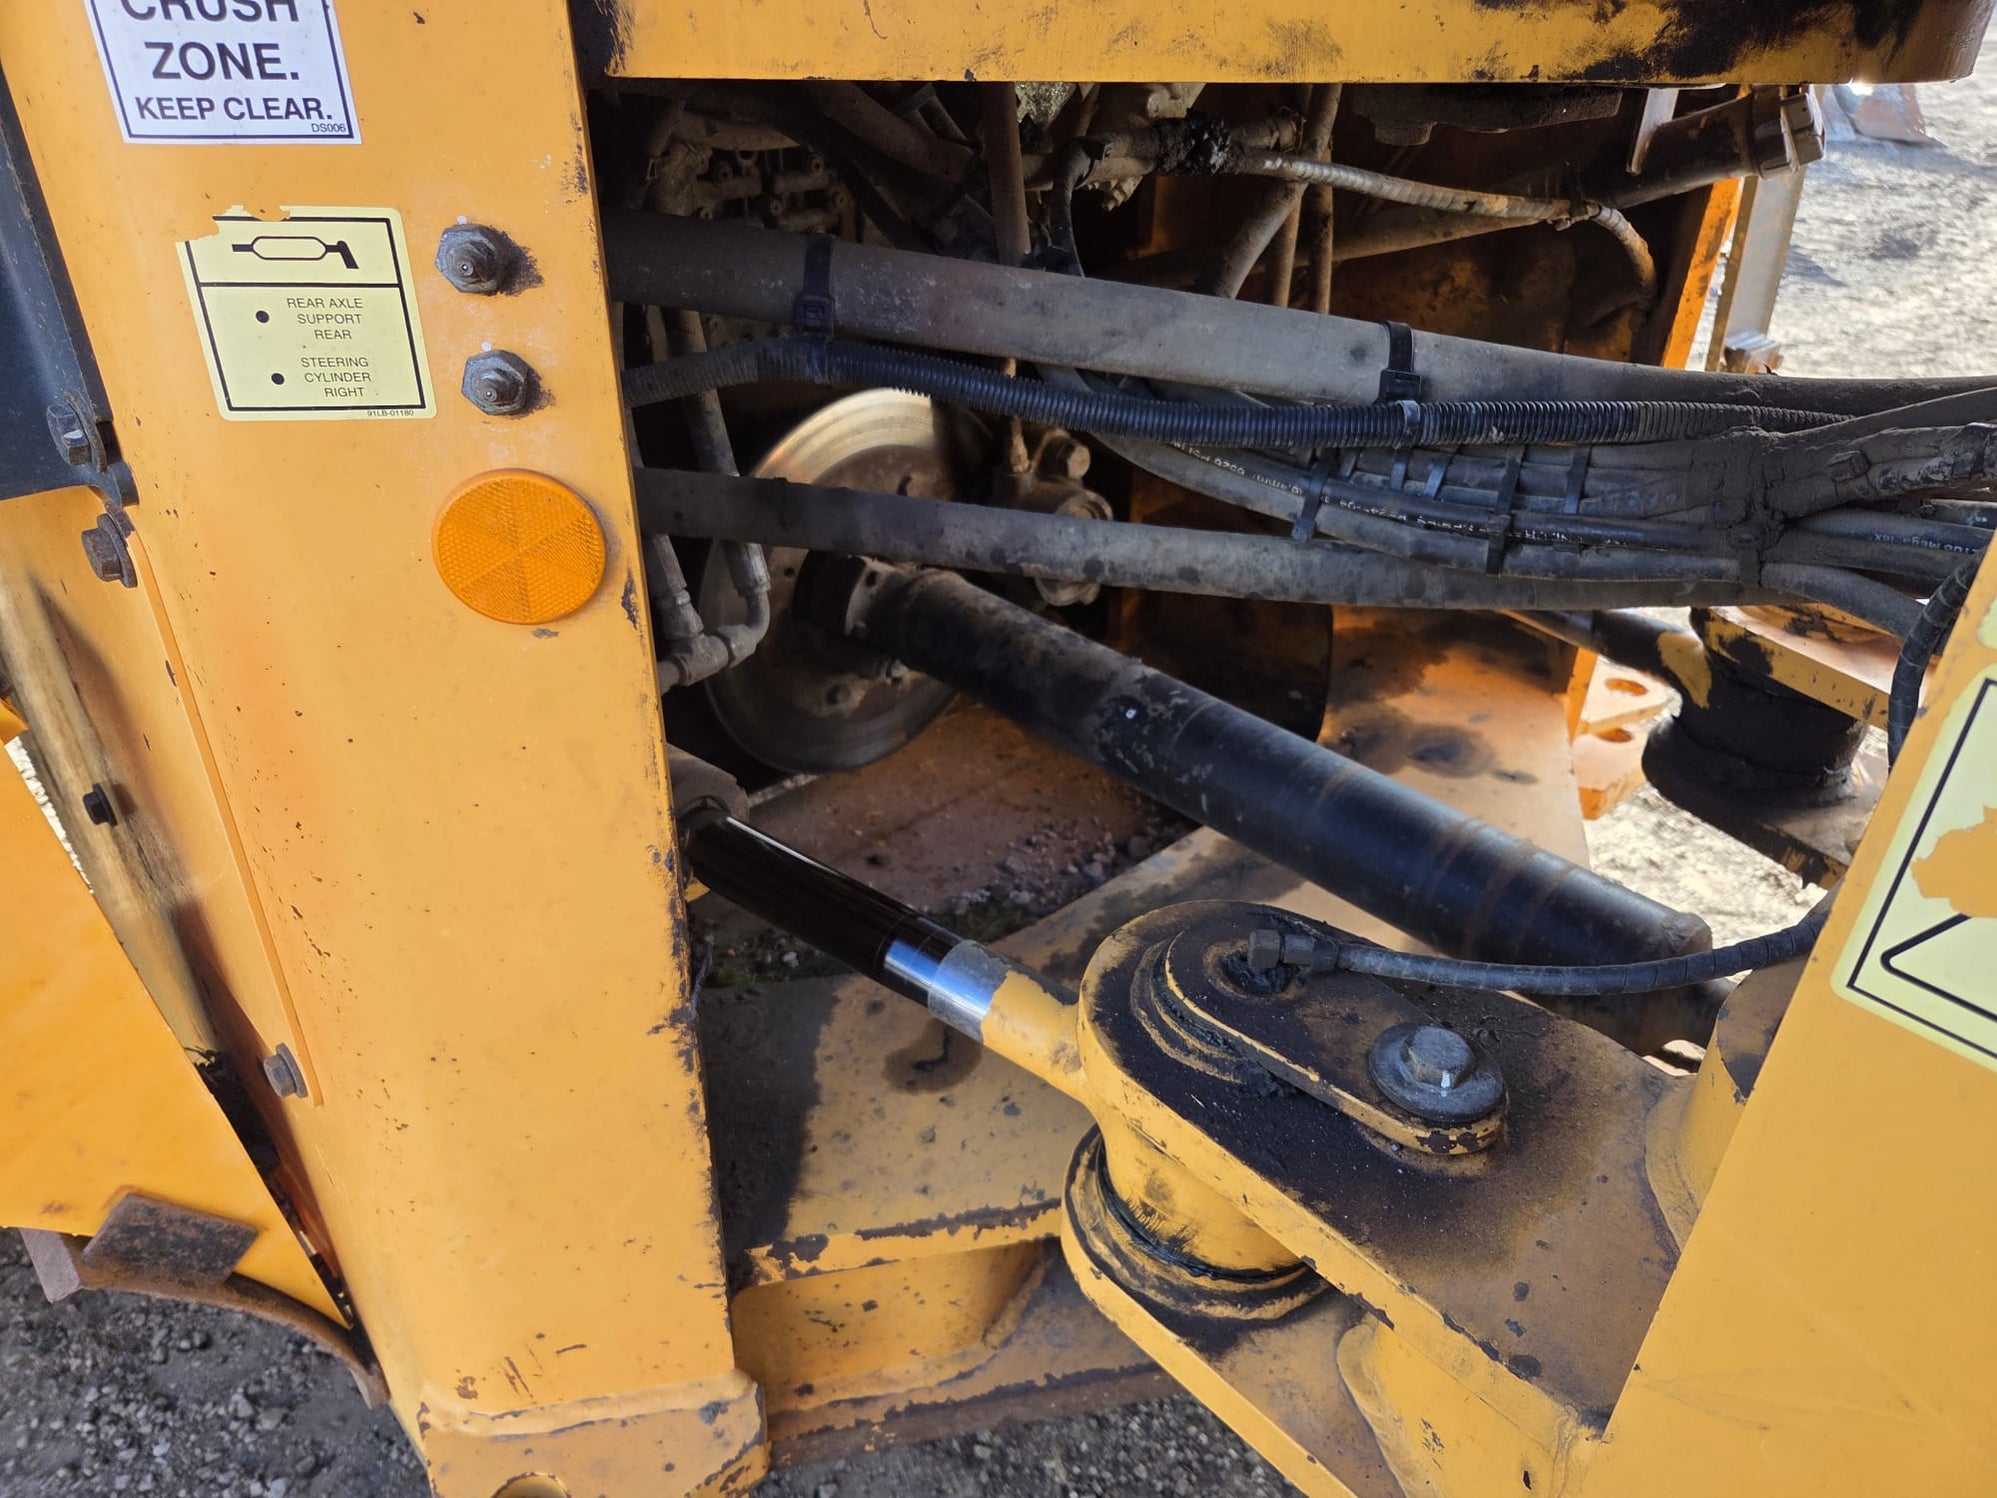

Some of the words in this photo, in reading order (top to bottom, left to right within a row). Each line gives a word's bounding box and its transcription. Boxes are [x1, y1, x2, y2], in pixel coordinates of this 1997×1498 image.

[144, 41, 301, 81] ZONE.
[134, 97, 216, 121] KEEP
[223, 97, 333, 121] CLEAR.
[311, 123, 347, 133] DS006
[287, 298, 326, 309] REAR
[329, 298, 364, 309] AXLE
[297, 314, 362, 325] SUPPORT
[315, 330, 352, 340] REAR
[300, 357, 369, 368] STEERING
[304, 372, 371, 383] CYLINDER
[324, 387, 365, 398] RIGHT
